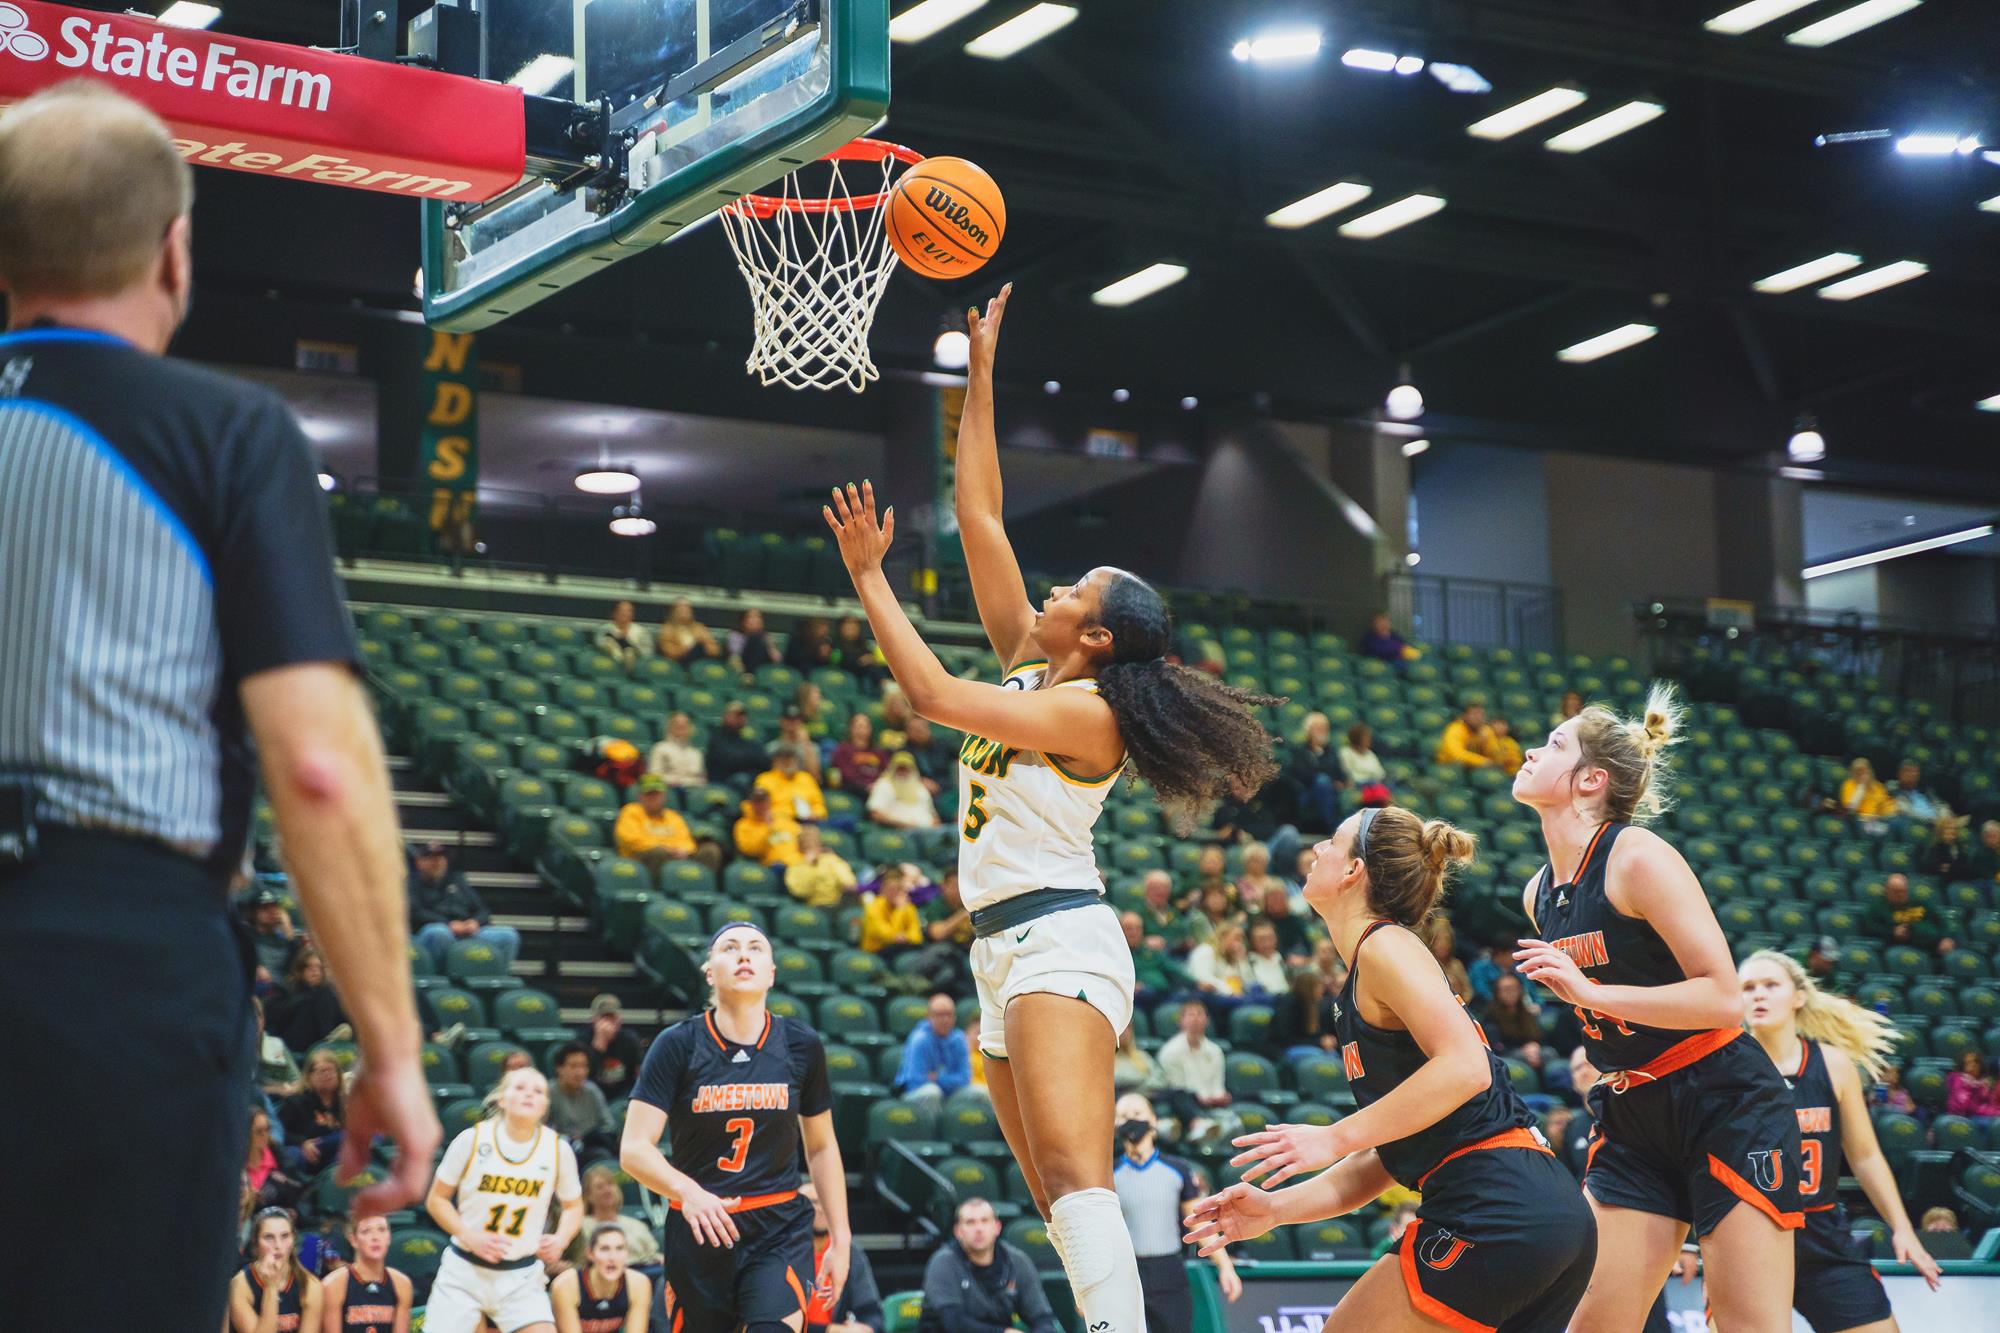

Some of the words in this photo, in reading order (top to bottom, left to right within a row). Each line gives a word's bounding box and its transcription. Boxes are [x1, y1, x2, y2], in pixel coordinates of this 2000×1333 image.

[172, 138, 283, 169] ate
[274, 154, 472, 196] Farm
[925, 185, 989, 247] Wilson
[963, 780, 989, 843] 5
[692, 1083, 789, 1113] JAMESTOWN
[717, 1118, 754, 1173] 3
[477, 1174, 545, 1200] BISON
[484, 1204, 528, 1237] 11
